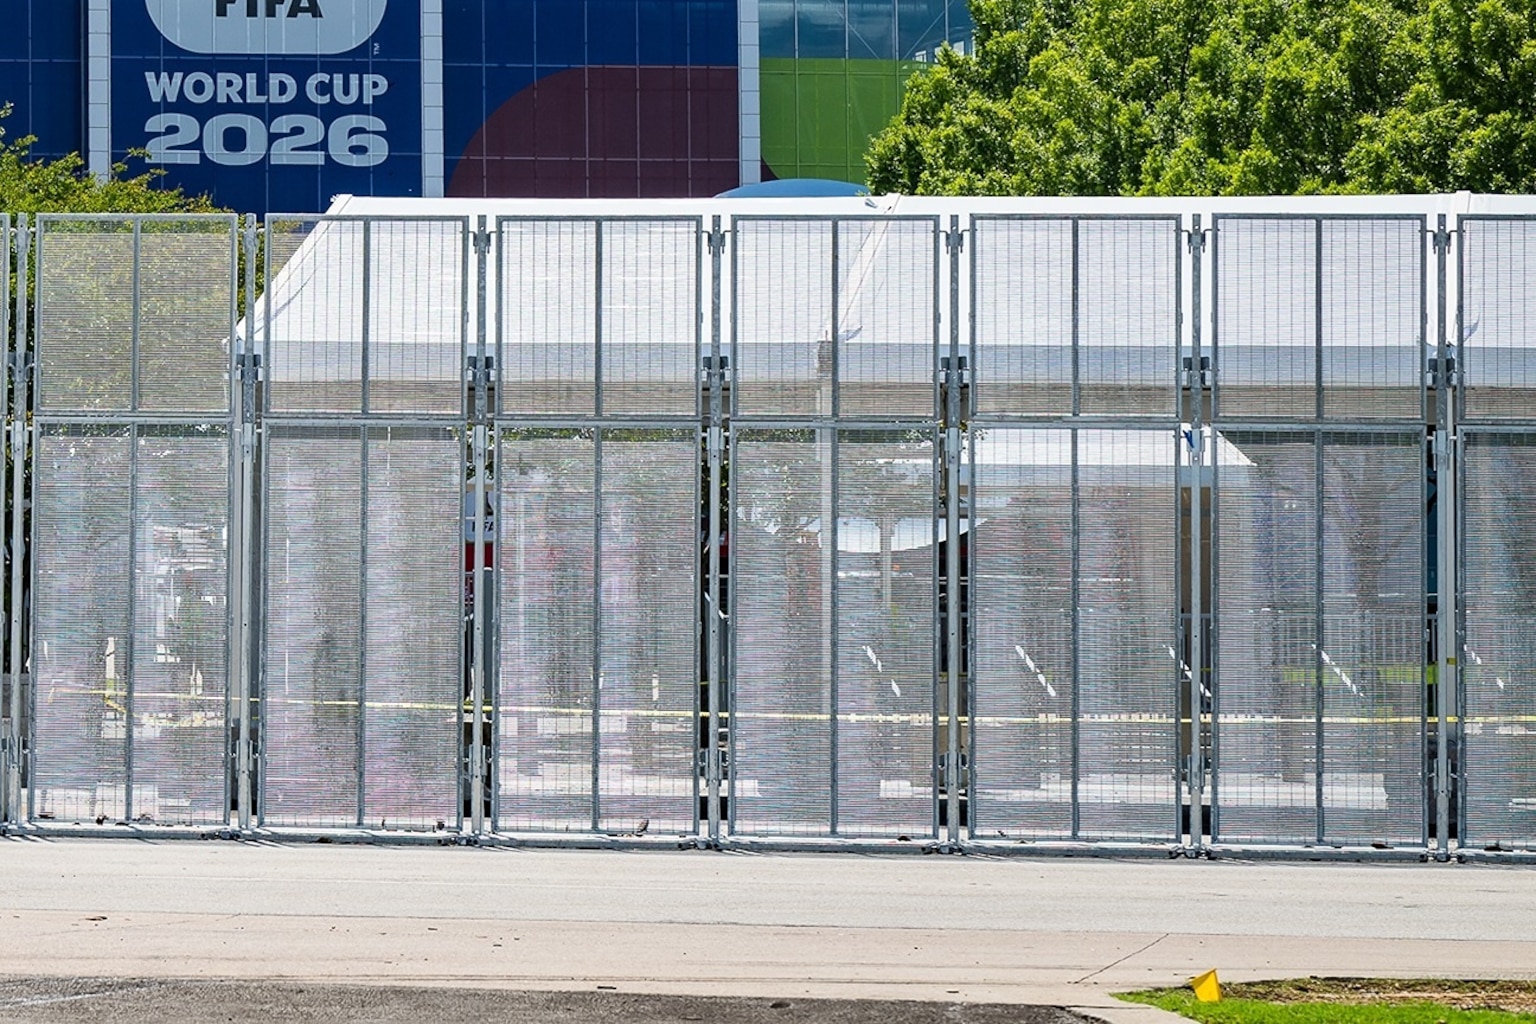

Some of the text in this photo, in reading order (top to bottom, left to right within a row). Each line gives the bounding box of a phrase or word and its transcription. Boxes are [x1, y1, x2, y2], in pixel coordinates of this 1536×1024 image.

[144, 71, 389, 105] WORLD CUP
[144, 113, 390, 167] 2026
